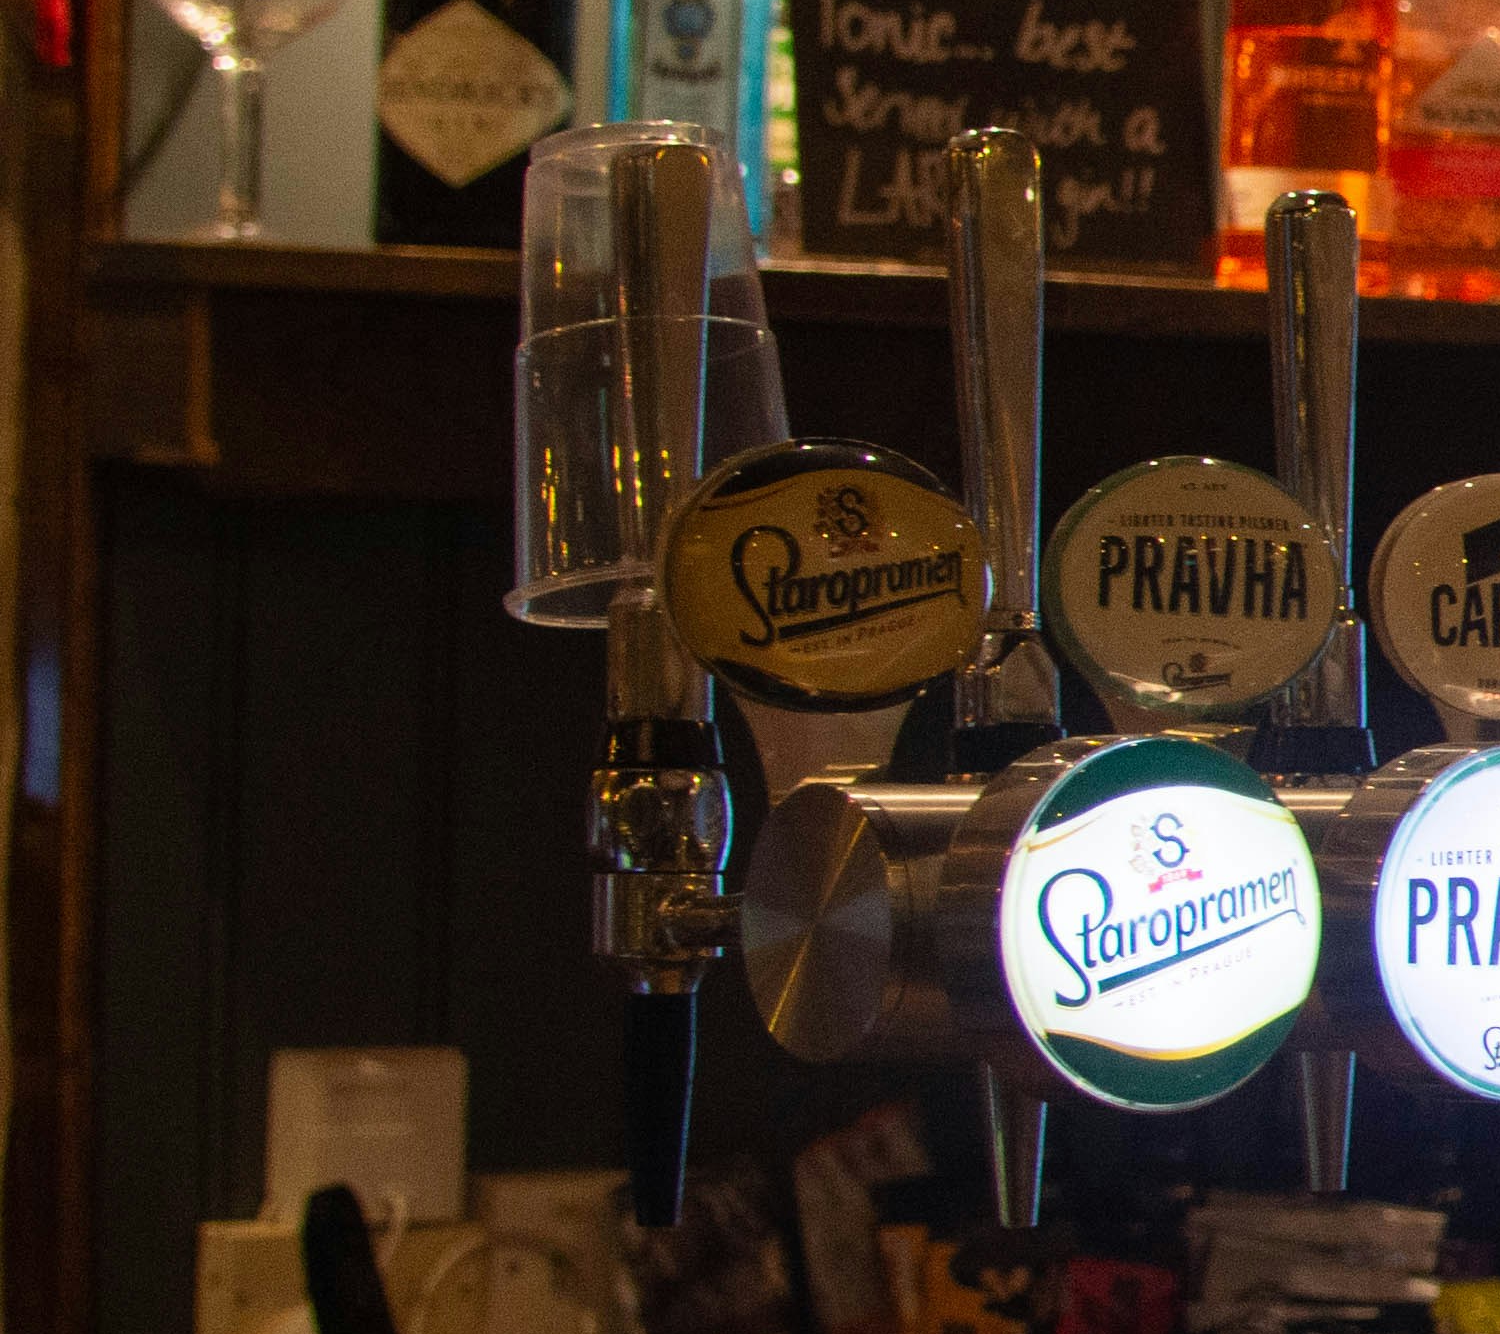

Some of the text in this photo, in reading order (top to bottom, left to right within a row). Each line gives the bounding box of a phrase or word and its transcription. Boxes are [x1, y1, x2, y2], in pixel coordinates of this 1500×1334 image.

[731, 525, 967, 648] Staropramen
[1098, 534, 1307, 622] PRAVHA
[1430, 849, 1492, 866] LIGHTER
[1038, 865, 1306, 1009] Staropramen
